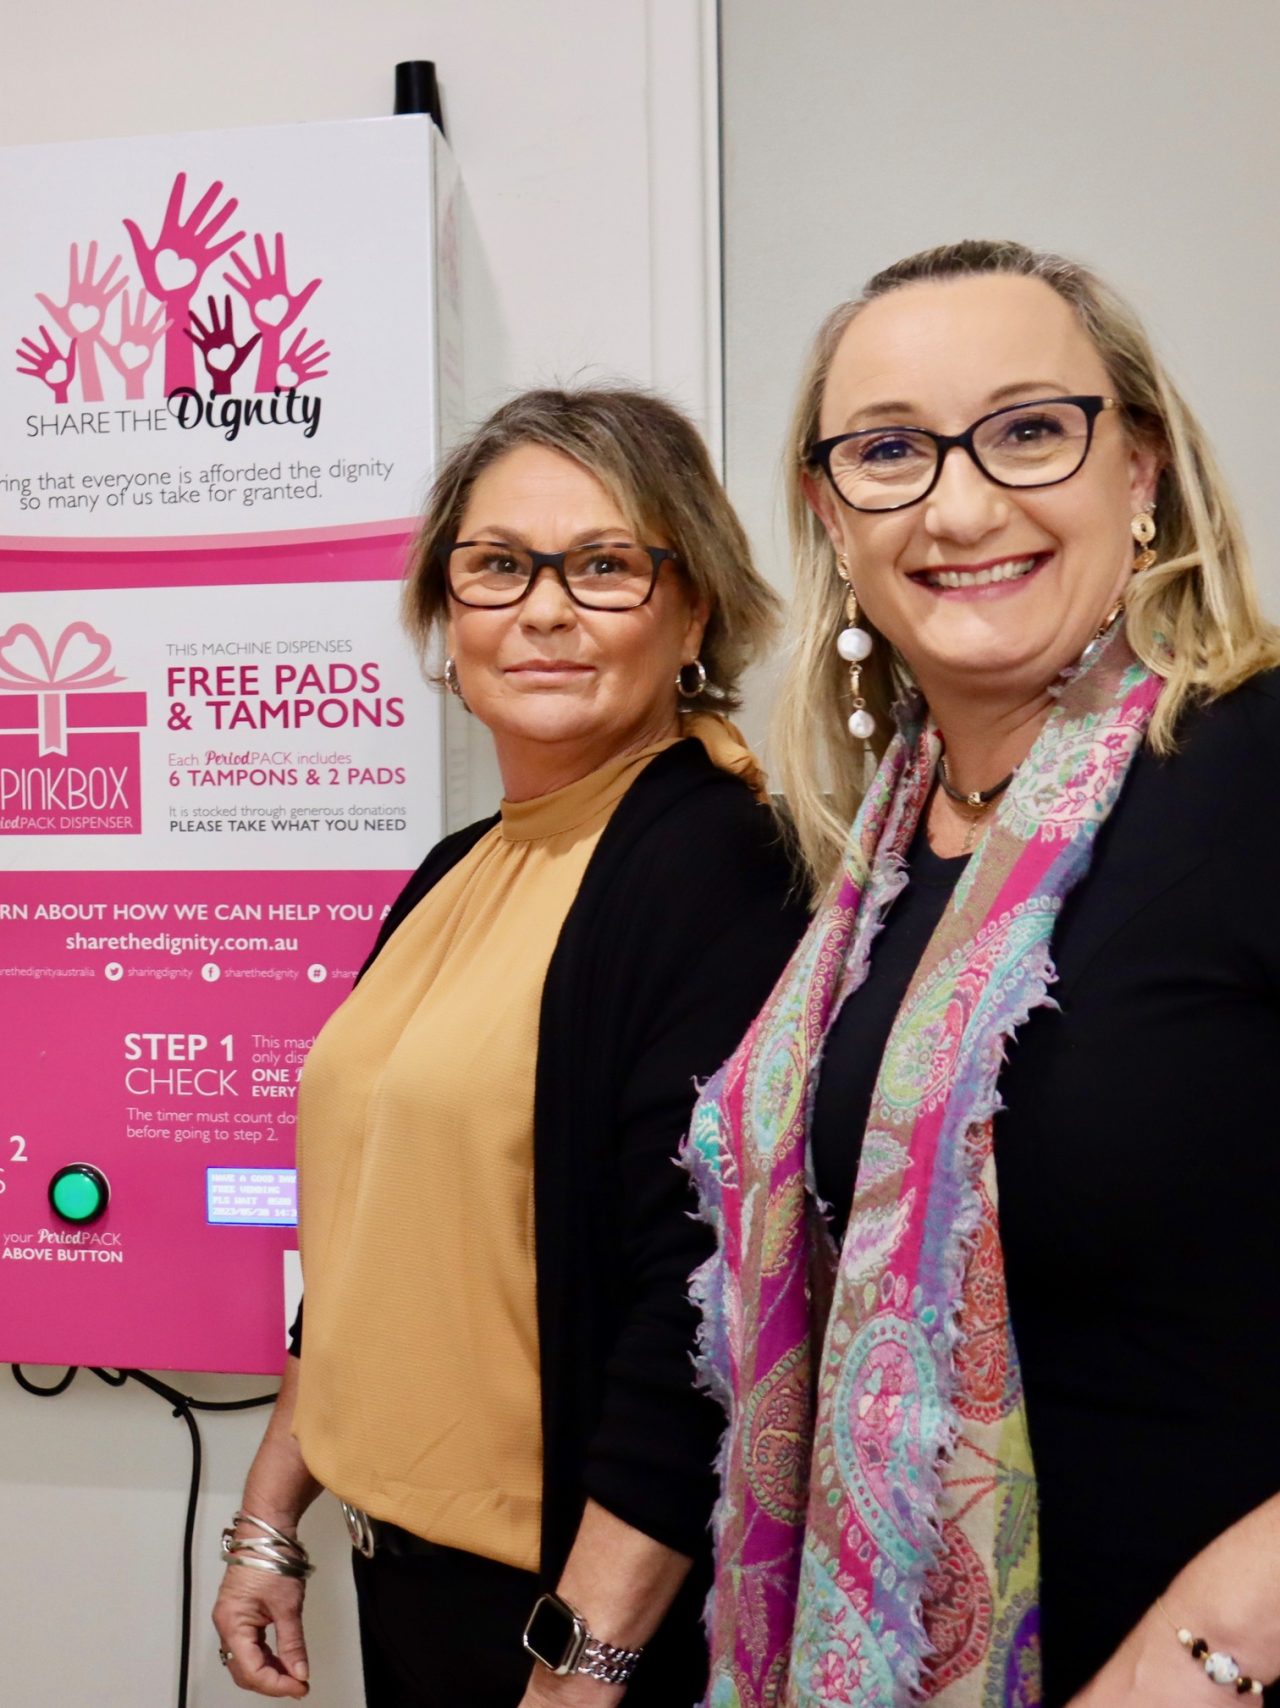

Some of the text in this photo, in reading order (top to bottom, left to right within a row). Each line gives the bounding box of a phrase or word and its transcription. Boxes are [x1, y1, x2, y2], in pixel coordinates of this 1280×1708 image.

[26, 386, 322, 442] SHARE THE Dignity
[38, 471, 75, 491] that
[82, 469, 171, 491] everyone
[179, 466, 192, 484] is
[199, 462, 282, 484] afforded
[289, 461, 321, 480] the
[329, 458, 394, 483] dignity
[20, 482, 322, 512] so many of us take for granted.
[166, 640, 353, 656] THIS MACHINE DISPENSES
[167, 662, 380, 697] FREE PADS
[166, 697, 405, 731] & TAMPONS
[169, 750, 352, 767] Each PeriodPACK includes
[169, 768, 406, 787] 6 TAMPONS & 2 PADS
[169, 804, 406, 821] It is stocked through generous donations
[60, 815, 133, 829] DISPENSER
[170, 819, 406, 832] PLEASE TAKE WHAT YOU NEED
[34, 904, 107, 920] ABOUT
[113, 904, 168, 920] HOW
[174, 904, 208, 920] WE
[214, 904, 262, 921] CAN
[269, 904, 320, 920] HELP
[326, 904, 372, 921] YOU
[379, 904, 392, 921] A
[66, 933, 298, 955] sharethedignity.com.au
[128, 968, 193, 980] sharingdignity
[225, 968, 299, 981] sharethedignity
[332, 969, 358, 979] share
[124, 1033, 233, 1061] STEP 1
[251, 1035, 317, 1048] This mac
[251, 1050, 306, 1066] only dis
[125, 1068, 238, 1096] CHECK
[251, 1069, 289, 1082] ONE
[252, 1085, 296, 1097] EVERY
[127, 1108, 297, 1124] The timer must count do
[127, 1126, 278, 1143] before going to step 2.
[10, 1135, 28, 1161] 2
[250, 1175, 274, 1183] GOOD
[4, 1232, 32, 1247] your
[37, 1229, 121, 1246] PeriodPACK
[2, 1247, 52, 1261] ABOVE
[57, 1249, 123, 1263] BUTTON
